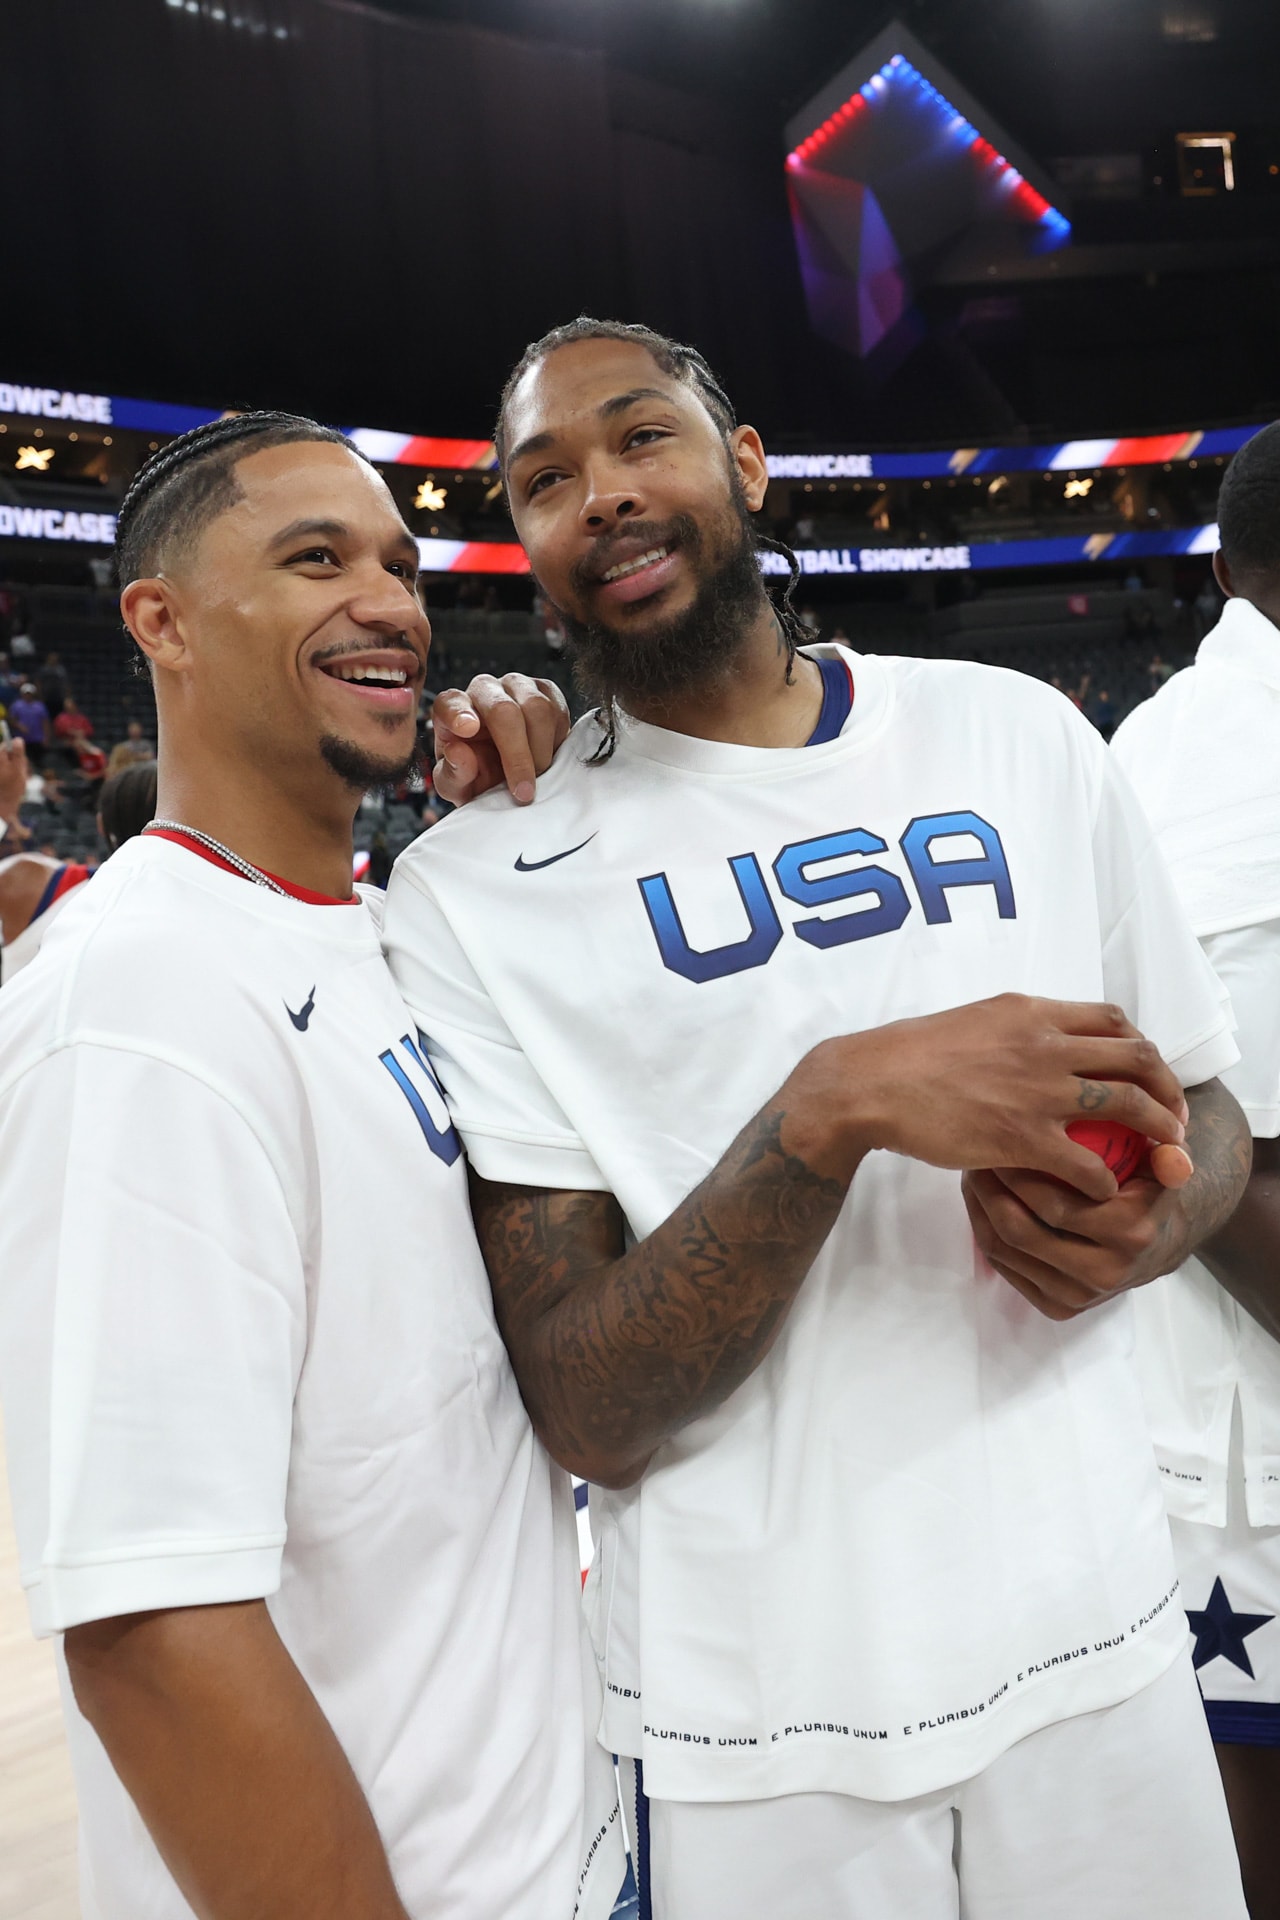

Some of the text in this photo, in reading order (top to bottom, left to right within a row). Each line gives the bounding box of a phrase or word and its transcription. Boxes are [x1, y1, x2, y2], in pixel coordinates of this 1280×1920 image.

[765, 454, 873, 477] SHOWCASE
[859, 546, 971, 572] SHOWCASE
[637, 810, 1017, 984] USA
[643, 1725, 711, 1745] PLURIBUS
[718, 1738, 758, 1746] UNUM
[771, 1732, 779, 1743] E
[784, 1723, 849, 1736] PLURIBUS
[853, 1729, 888, 1740] UNUM
[903, 1726, 912, 1736] E
[918, 1703, 985, 1732] PLURIBUS
[988, 1682, 1009, 1706] UNUM
[1016, 1672, 1024, 1682] E
[1027, 1647, 1089, 1677] PLURIBUS
[1093, 1633, 1125, 1652] UNUM
[1130, 1624, 1137, 1634] E
[1139, 1594, 1170, 1628] PLURIBUS
[580, 1825, 607, 1885] PLURIBUS
